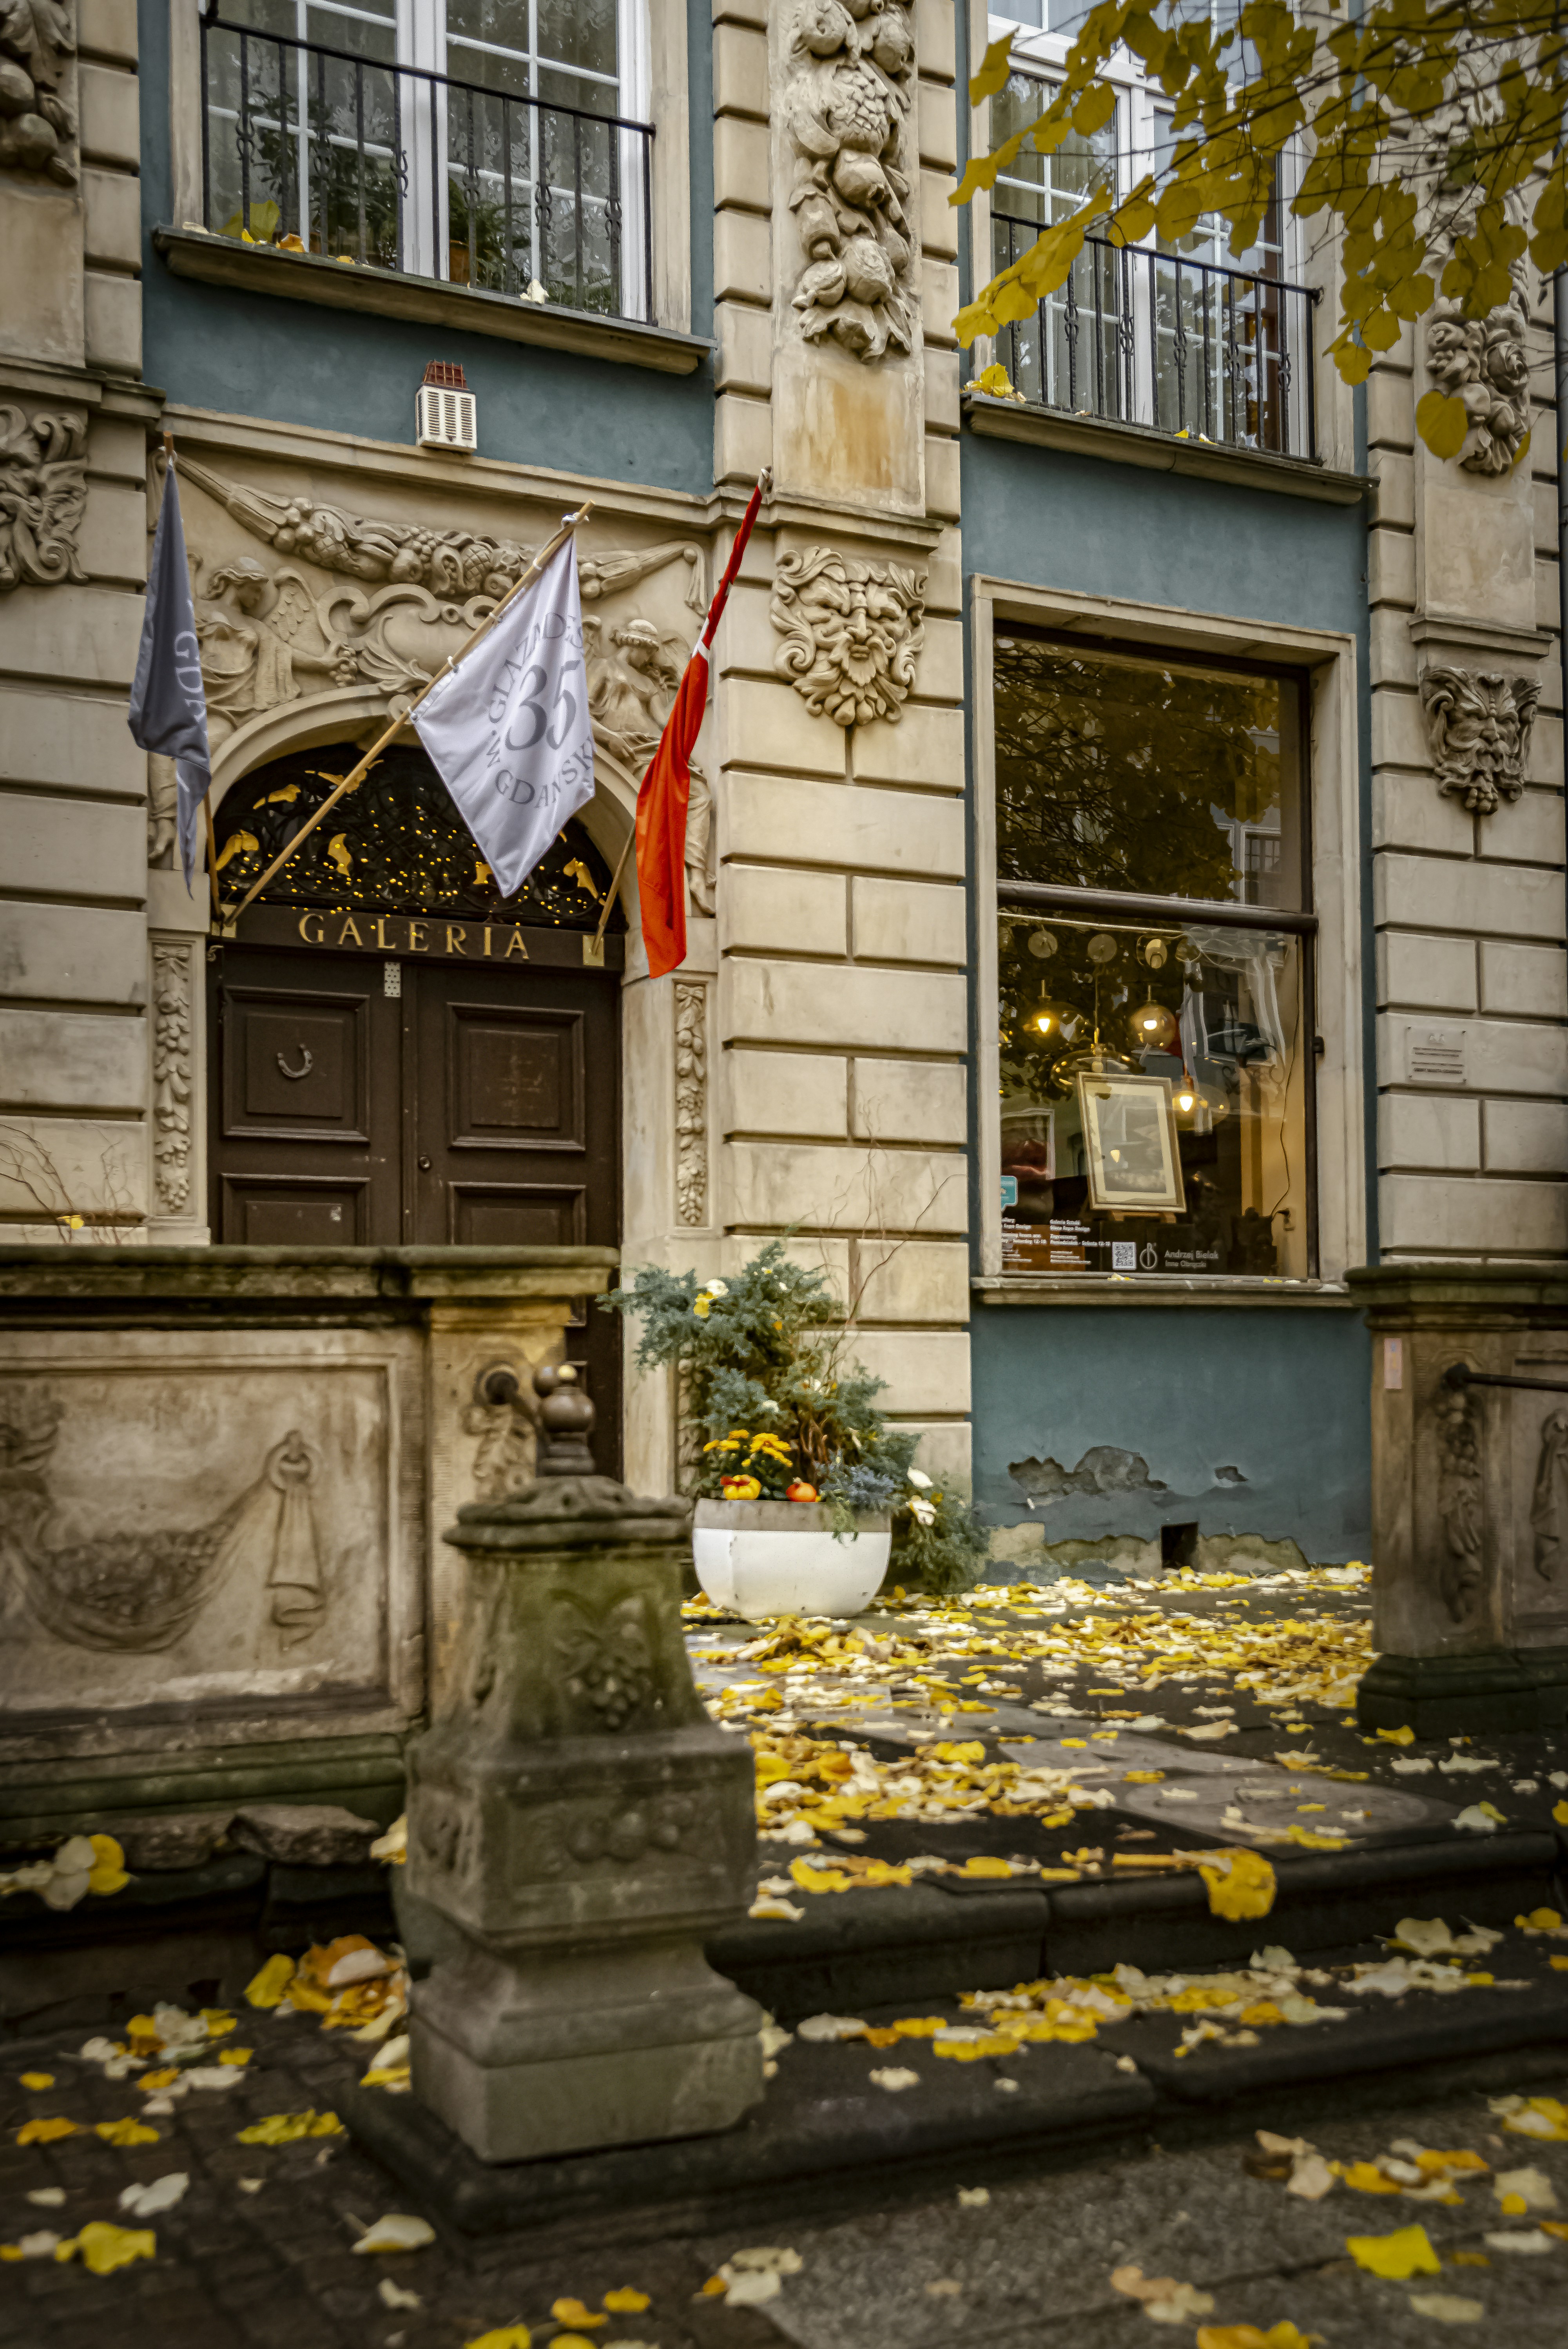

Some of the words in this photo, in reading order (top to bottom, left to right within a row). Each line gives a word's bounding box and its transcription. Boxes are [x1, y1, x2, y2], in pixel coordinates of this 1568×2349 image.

[505, 660, 581, 751] 35
[299, 914, 529, 960] GALERIA
[1164, 1250, 1193, 1261] Andrzej
[1196, 1250, 1218, 1259] Bielak
